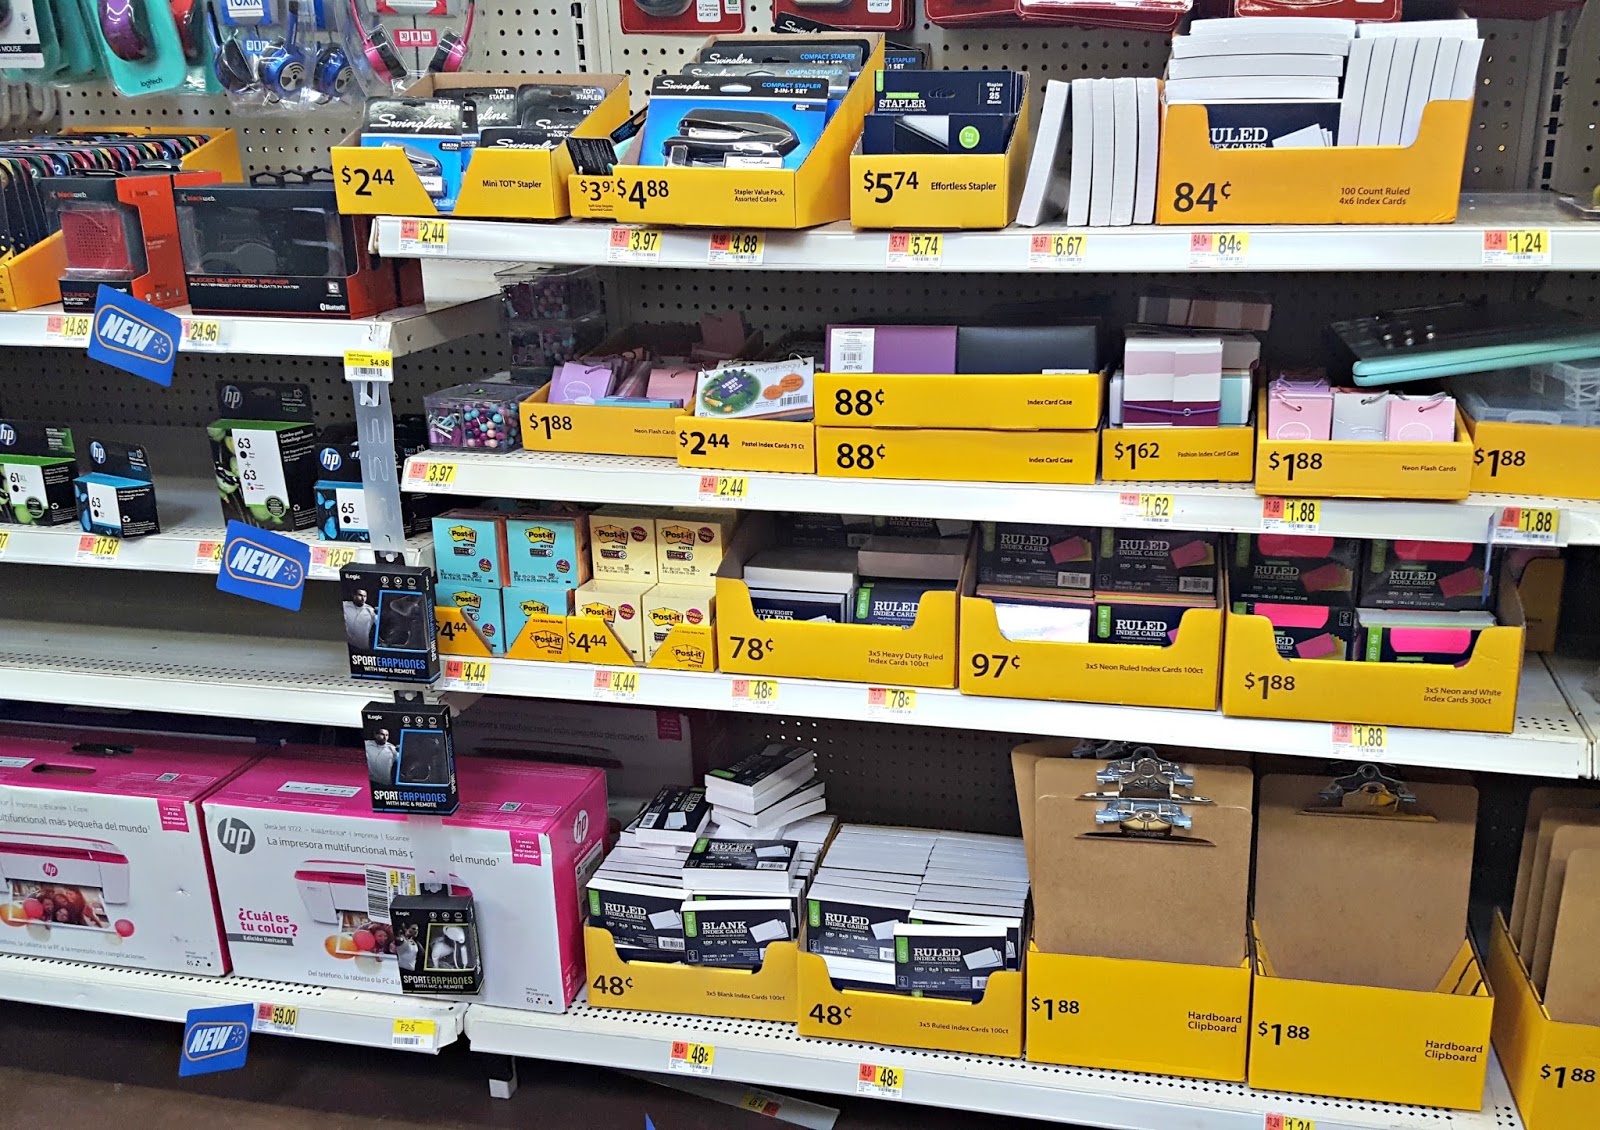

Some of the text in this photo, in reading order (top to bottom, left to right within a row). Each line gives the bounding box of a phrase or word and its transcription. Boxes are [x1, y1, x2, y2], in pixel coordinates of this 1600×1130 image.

[140, 77, 163, 88] logitech
[656, 80, 711, 92] Swingline
[989, 92, 1000, 100] 25
[879, 99, 926, 108] STAPLER
[370, 114, 453, 132] Swingline
[931, 182, 996, 192] Effortless Stapler
[1340, 187, 1410, 195] 100 Count Ruled
[1339, 197, 1406, 205] 4x6 Index Cards
[100, 314, 156, 353] NEW
[370, 359, 390, 367] $4.96
[238, 438, 251, 449] 63
[761, 441, 775, 449] Index
[92, 446, 105, 463] hp
[323, 453, 339, 470] hp
[243, 470, 257, 480] 63
[91, 496, 101, 508] 63
[341, 503, 355, 514] 65
[600, 530, 625, 539] Post-it
[666, 531, 692, 540] Post-it
[1001, 533, 1049, 546] RULED
[1119, 539, 1170, 551] RULED
[230, 546, 286, 579] NEW
[1254, 565, 1299, 576] RULED
[1389, 570, 1436, 581] RULED
[586, 607, 613, 617] Post-it
[653, 613, 680, 621] Post-it
[1116, 620, 1167, 631] RULED
[1116, 629, 1166, 638] INDEX CARDS
[535, 636, 560, 644] Post-it
[675, 649, 702, 658] Post-it
[882, 651, 903, 659] Heavy
[905, 652, 921, 660] Duty
[1100, 663, 1118, 671] Neon
[1119, 664, 1140, 672] Ruled
[1162, 666, 1182, 674] Cards
[1425, 687, 1502, 697] 3x5 Neon and White
[1446, 696, 1468, 705] Cards
[1470, 697, 1492, 705] 300ct
[50, 818, 117, 831] más pequeña del
[223, 818, 251, 854] hp
[267, 837, 408, 858] La impresora multifuncional más
[450, 854, 463, 863] del
[604, 903, 647, 916] RULED
[275, 915, 289, 923] es
[825, 912, 870, 926] RULED
[241, 921, 256, 931] tu
[702, 922, 746, 930] BLANK
[825, 921, 847, 929] INDEX
[913, 947, 961, 957] RULED
[734, 992, 750, 1000] Index
[1188, 1010, 1242, 1025] Hardboard
[400, 1024, 415, 1032] F2-5
[971, 1025, 989, 1033] Cards
[1188, 1020, 1238, 1035] Clipboard
[189, 1026, 233, 1053] NEW
[1425, 1039, 1483, 1054] Hardboard
[1424, 1048, 1477, 1064] Clipboard
